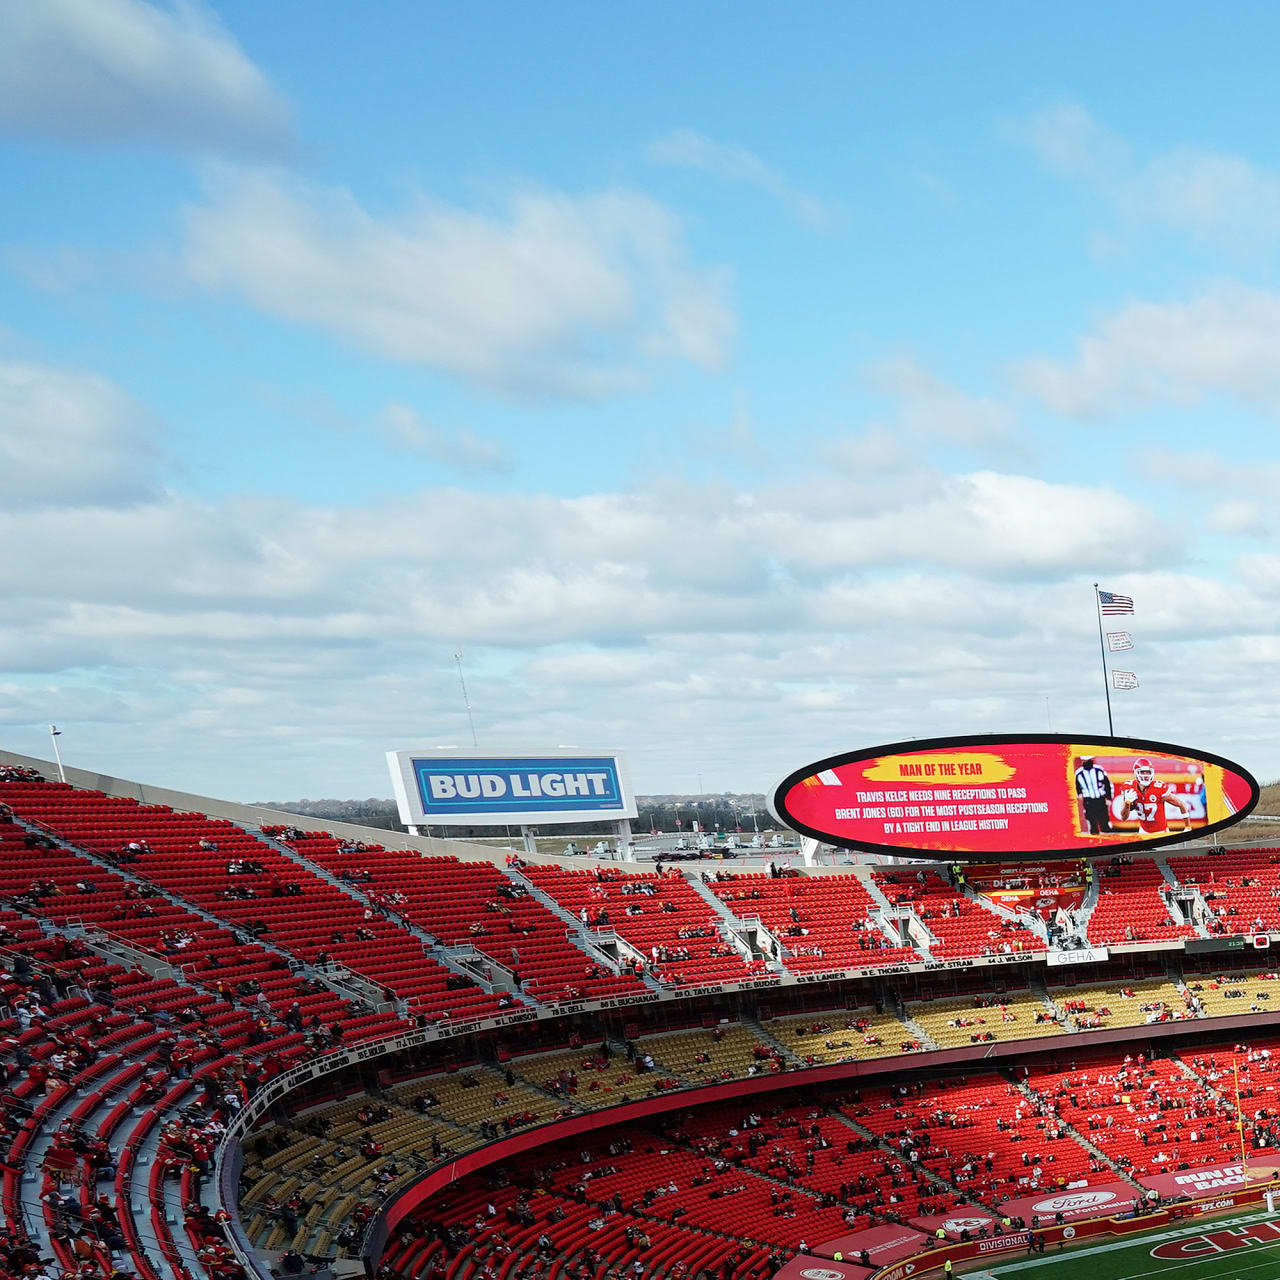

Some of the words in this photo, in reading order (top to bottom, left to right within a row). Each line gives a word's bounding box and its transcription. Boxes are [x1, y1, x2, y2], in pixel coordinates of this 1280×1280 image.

[899, 764, 922, 776] MAN
[924, 764, 937, 776] OF
[938, 763, 956, 776] THE
[957, 763, 983, 775] YEAR
[429, 775, 507, 799] BUD
[509, 773, 608, 797] LIGHT
[856, 792, 884, 803] TRAVIS
[885, 791, 909, 802] KELCE
[909, 790, 934, 801] NEEDS
[934, 790, 952, 801] NINE
[952, 788, 997, 800] RECEPTIONS
[997, 788, 1007, 799] TO
[1007, 788, 1027, 798] PASS
[835, 808, 861, 820] BRENT
[863, 807, 886, 819] JONES
[887, 806, 904, 818] (60)
[904, 806, 920, 817] FOR
[920, 805, 935, 817] THE
[936, 804, 957, 816] MOST
[958, 804, 1005, 815] POSTSEASON
[1006, 802, 1049, 814] RECEPTIONS
[884, 823, 895, 834] BY
[896, 822, 903, 833] A
[902, 822, 924, 833] TIGHT
[925, 821, 940, 832] END
[941, 821, 950, 831] IN
[951, 820, 978, 831] LEAGUE
[978, 818, 1009, 830] HISTORY
[1004, 954, 1033, 963] WILSON
[1058, 951, 1096, 963] GEHA
[877, 966, 910, 975] THOMAS
[947, 960, 974, 969] STRAM
[816, 972, 846, 982] LANIER
[693, 986, 723, 996] TAYLOR
[618, 994, 660, 1006] BUCHANAN
[1174, 1169, 1226, 1185] RUN
[1194, 1174, 1254, 1191] BACK
[1052, 1193, 1100, 1211] Ford
[980, 1236, 1028, 1251] DIVISIONAL
